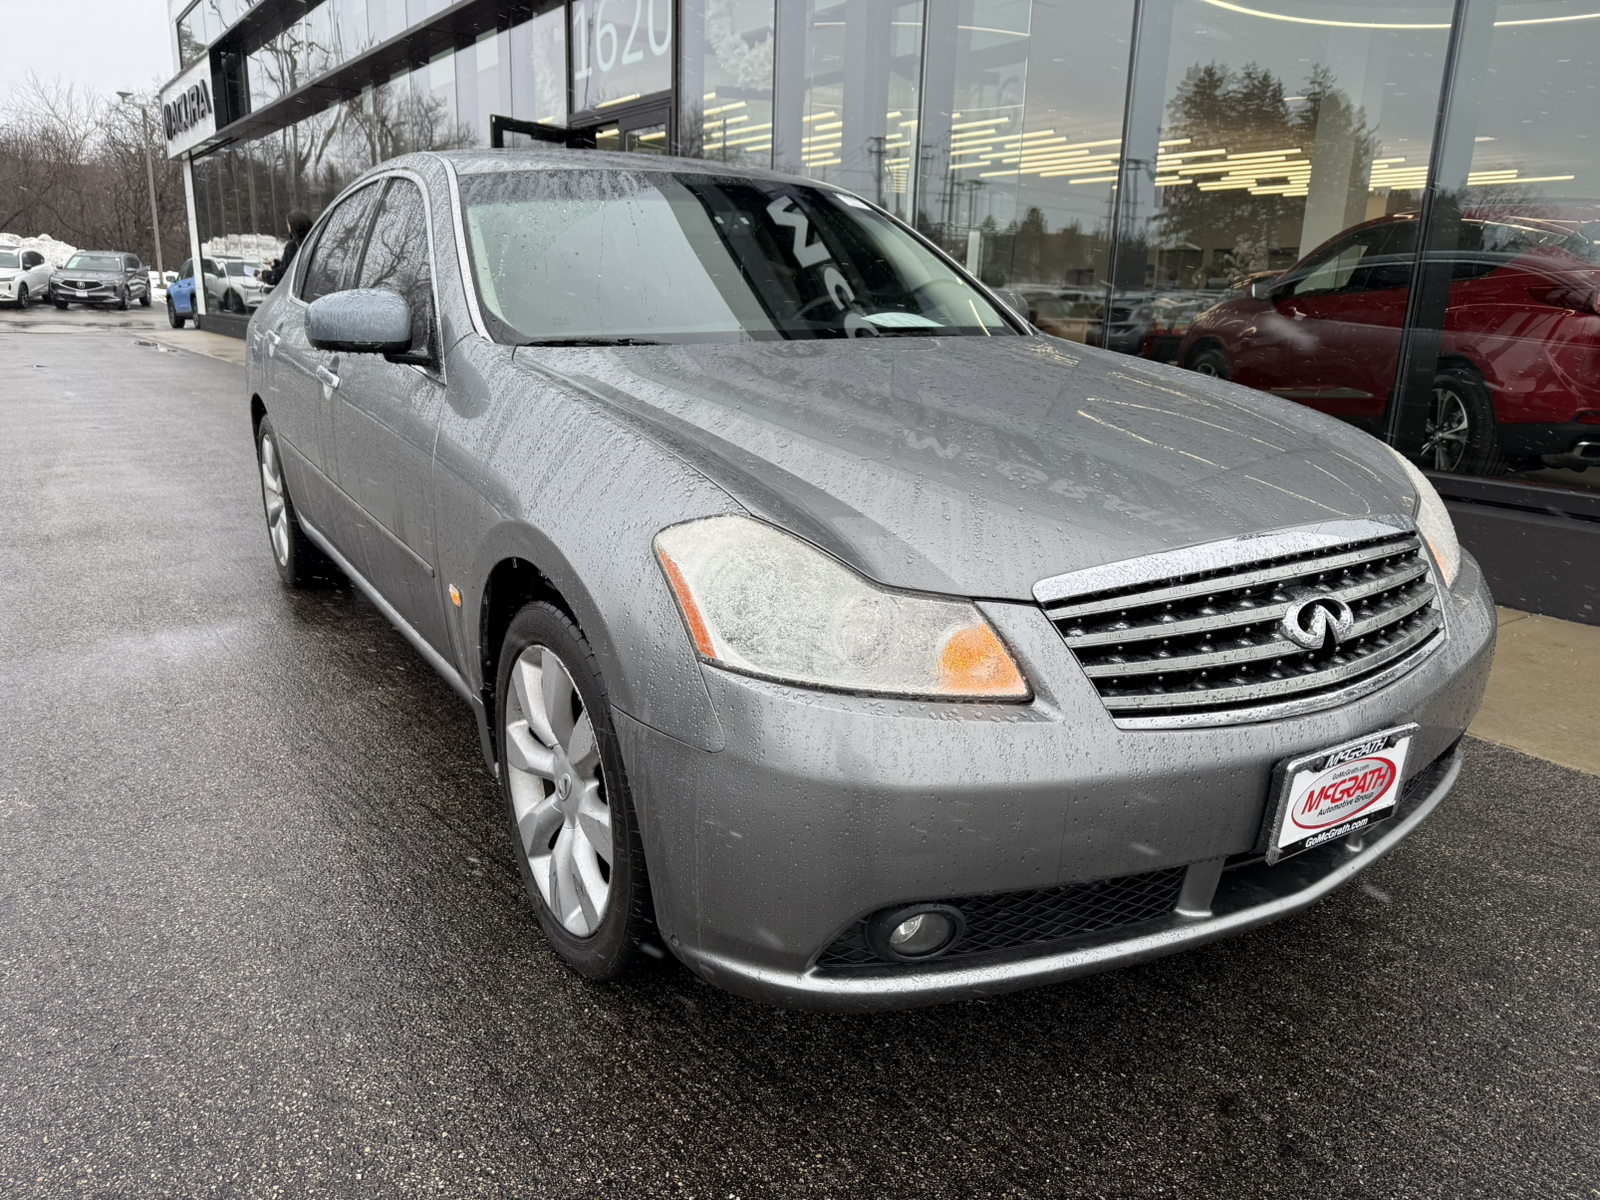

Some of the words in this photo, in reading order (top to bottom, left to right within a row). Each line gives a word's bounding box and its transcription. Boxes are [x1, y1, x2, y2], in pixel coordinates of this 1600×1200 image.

[574, 0, 671, 80] 1620
[171, 79, 212, 135] ACURA
[1317, 799, 1353, 817] Automotive
[1354, 792, 1374, 805] Group
[1305, 818, 1369, 848] GoMcGrath.com
